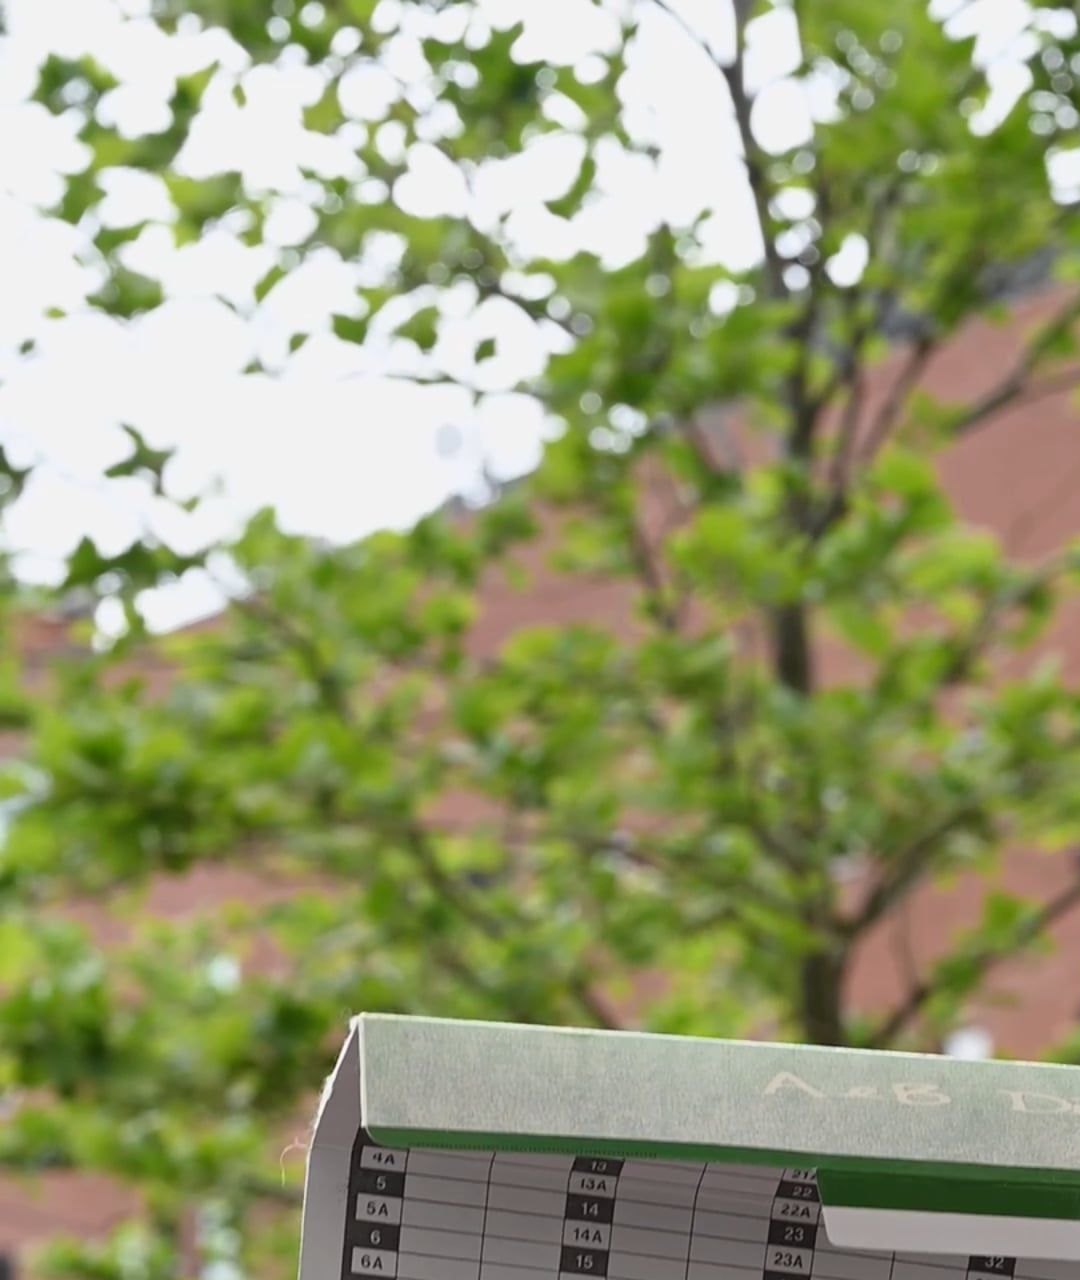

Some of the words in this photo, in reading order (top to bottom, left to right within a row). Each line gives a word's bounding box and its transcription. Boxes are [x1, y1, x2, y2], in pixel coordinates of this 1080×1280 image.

[373, 1152, 395, 1165] 4A
[375, 1175, 386, 1190] 5
[580, 1178, 607, 1192] 13A
[791, 1183, 813, 1198] 22
[367, 1201, 389, 1217] 5A
[581, 1202, 599, 1217] 14
[781, 1203, 811, 1218] 22A
[370, 1229, 381, 1245] 6
[574, 1228, 602, 1243] 14A
[784, 1227, 804, 1241] 23
[361, 1254, 383, 1270] 6A
[576, 1254, 593, 1269] 15
[774, 1252, 803, 1268] 23A
